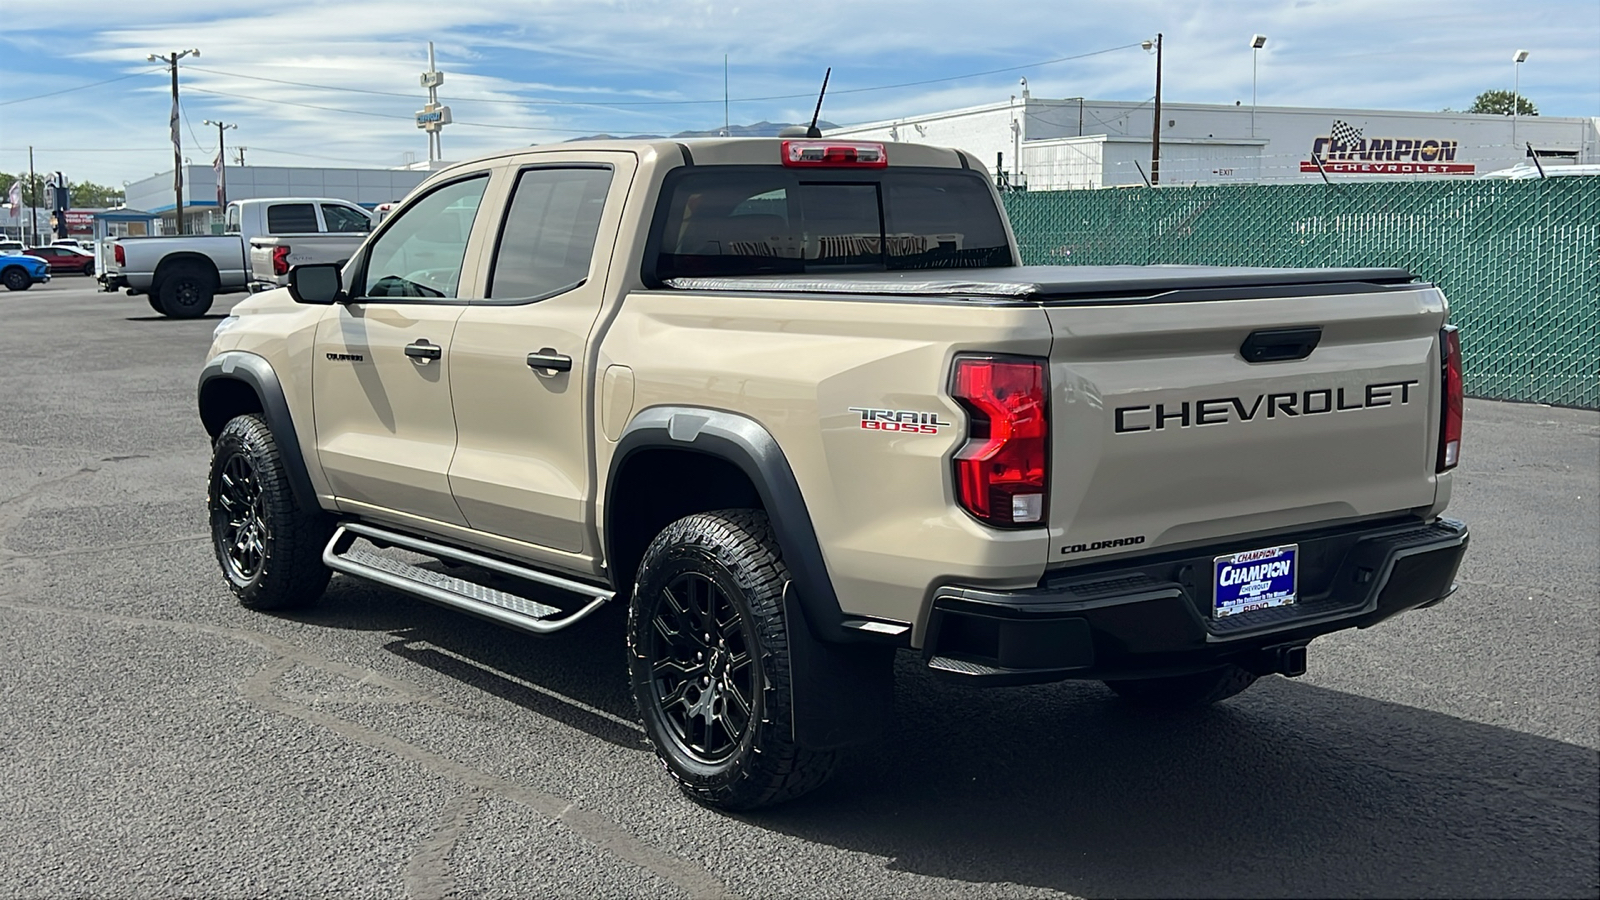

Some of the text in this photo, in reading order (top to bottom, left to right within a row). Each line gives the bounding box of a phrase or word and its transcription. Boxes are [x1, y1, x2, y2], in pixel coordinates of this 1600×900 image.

[1311, 137, 1458, 165] CHAMPION
[1219, 168, 1234, 176] EXIT
[1333, 163, 1450, 173] CHEVROLET
[1114, 379, 1419, 434] CHEVROLET
[848, 407, 952, 426] TRAIL
[861, 420, 938, 435] BOSS
[1061, 535, 1145, 554] COLORADO
[1238, 549, 1276, 562] CHAMPION
[1220, 560, 1290, 586] CHAMPION
[1242, 583, 1268, 593] CHEVROLET
[1244, 603, 1268, 612] RENO
